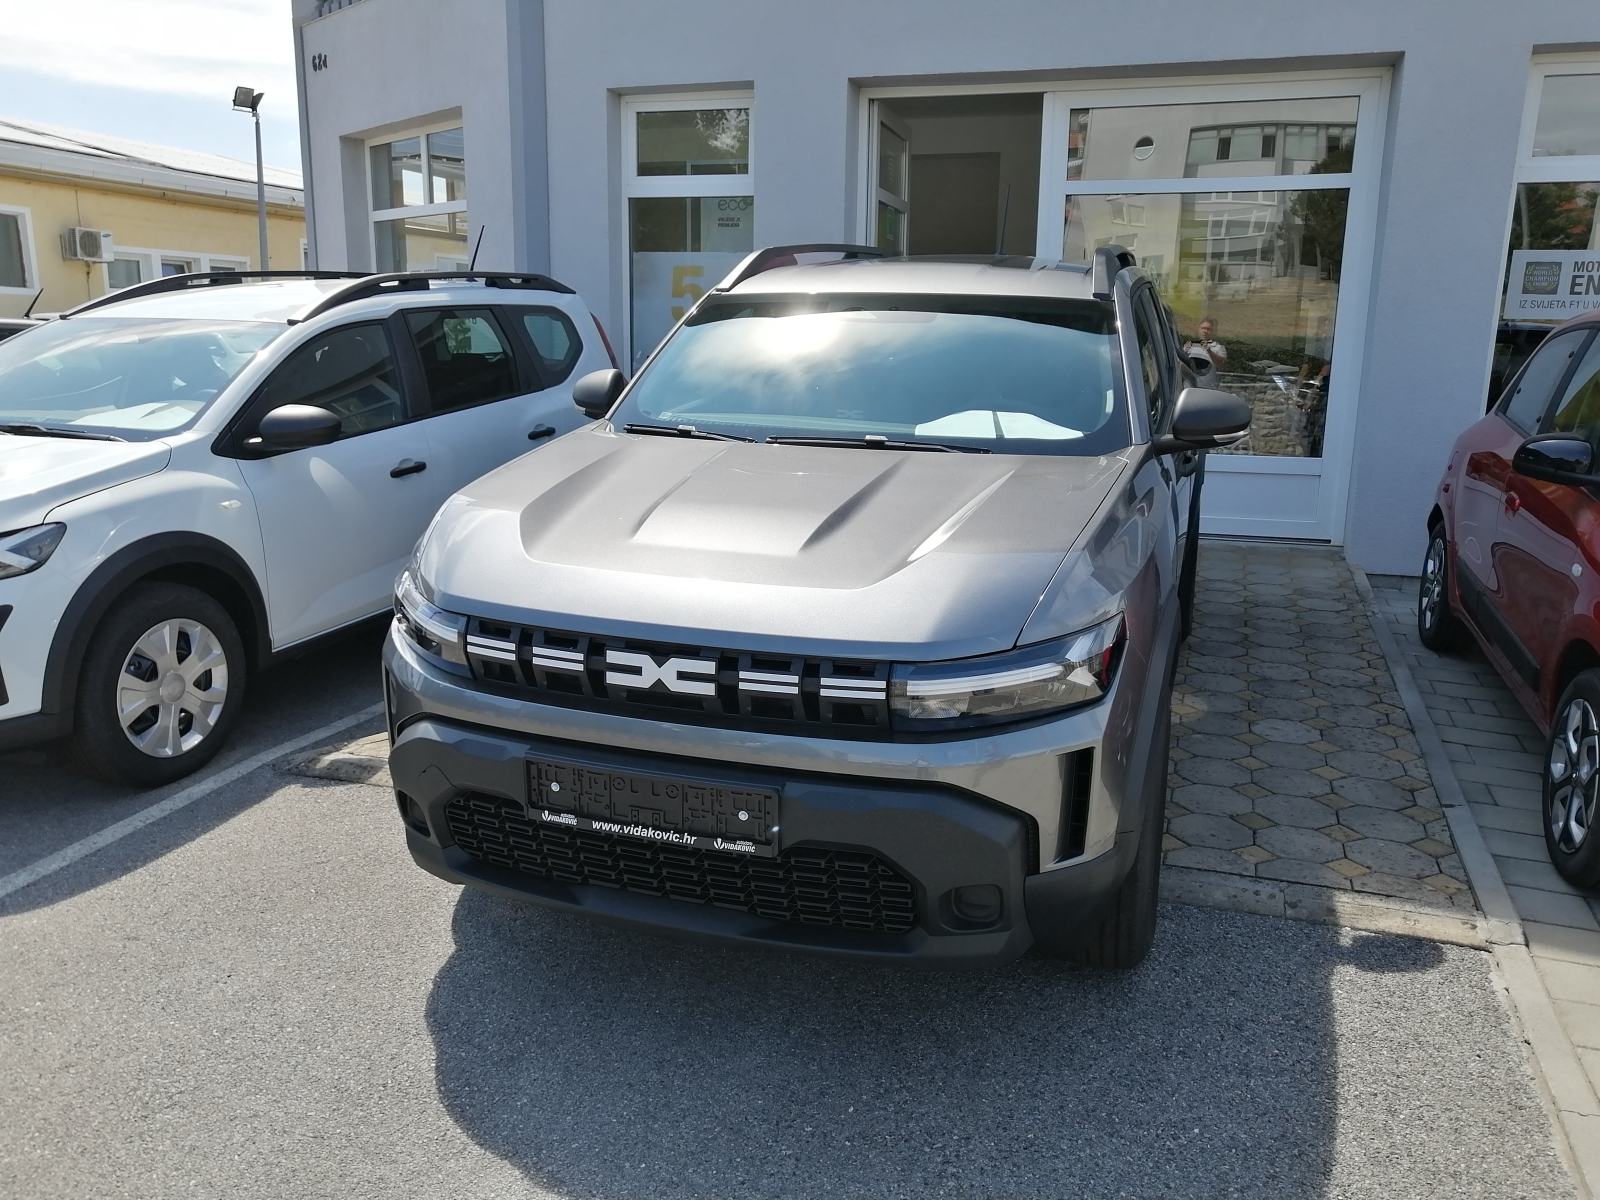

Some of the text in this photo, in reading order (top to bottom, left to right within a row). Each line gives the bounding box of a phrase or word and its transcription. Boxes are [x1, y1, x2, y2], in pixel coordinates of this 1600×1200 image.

[671, 265, 705, 322] 5
[1569, 274, 1600, 296] EN
[1518, 299, 1528, 309] IZ
[1529, 299, 1567, 309] SVIJETA
[1569, 300, 1580, 309] F1
[591, 820, 698, 845] www.vidakovic.hr
